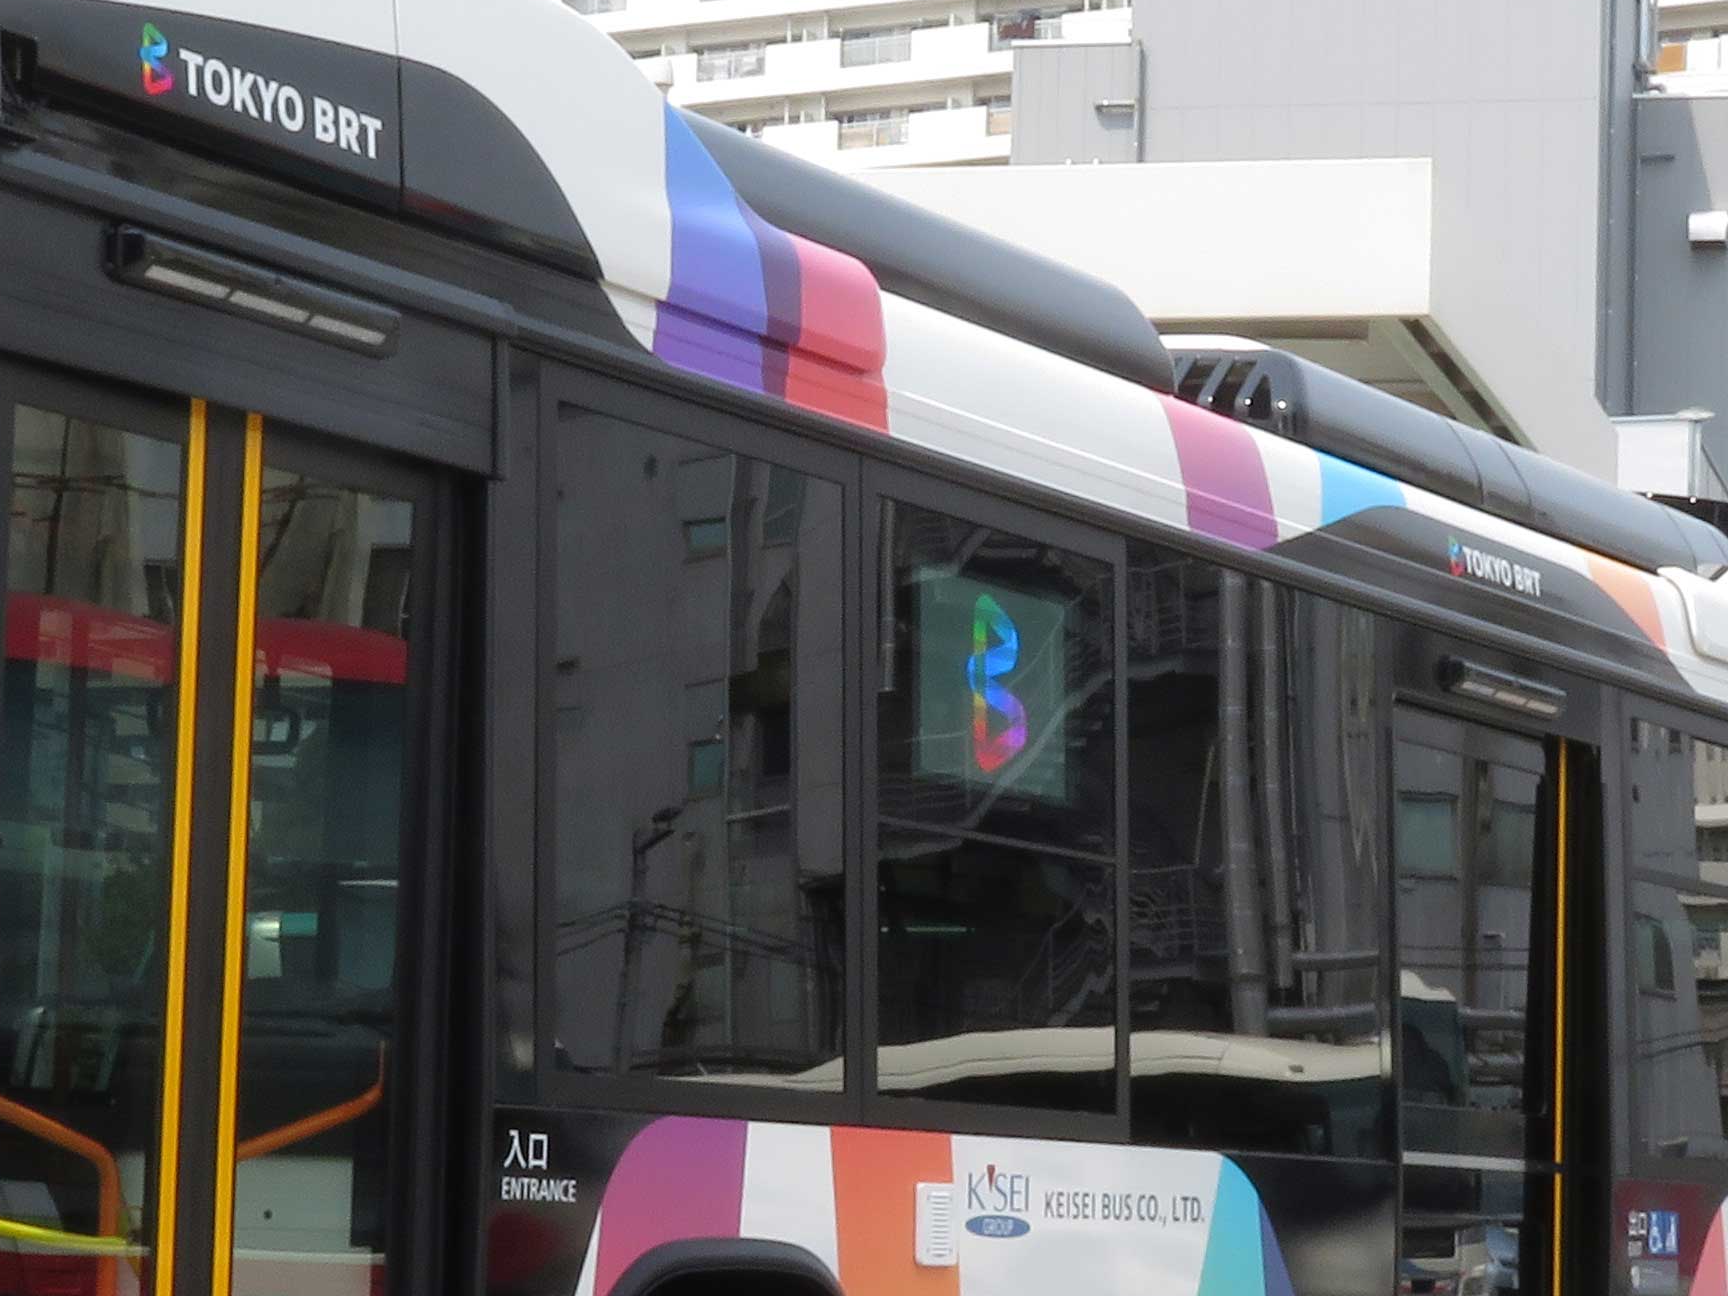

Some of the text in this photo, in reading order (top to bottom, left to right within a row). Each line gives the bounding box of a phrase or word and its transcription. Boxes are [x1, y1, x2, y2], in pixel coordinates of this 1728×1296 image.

[178, 47, 306, 133] TOKYO
[312, 95, 384, 160] BRT
[1461, 545, 1542, 598] TOKYO BRT
[503, 1129, 549, 1170] 入口
[500, 1176, 578, 1203] ENTRANCE
[1043, 1190, 1206, 1228] KEISEI BUS CO., LTD.
